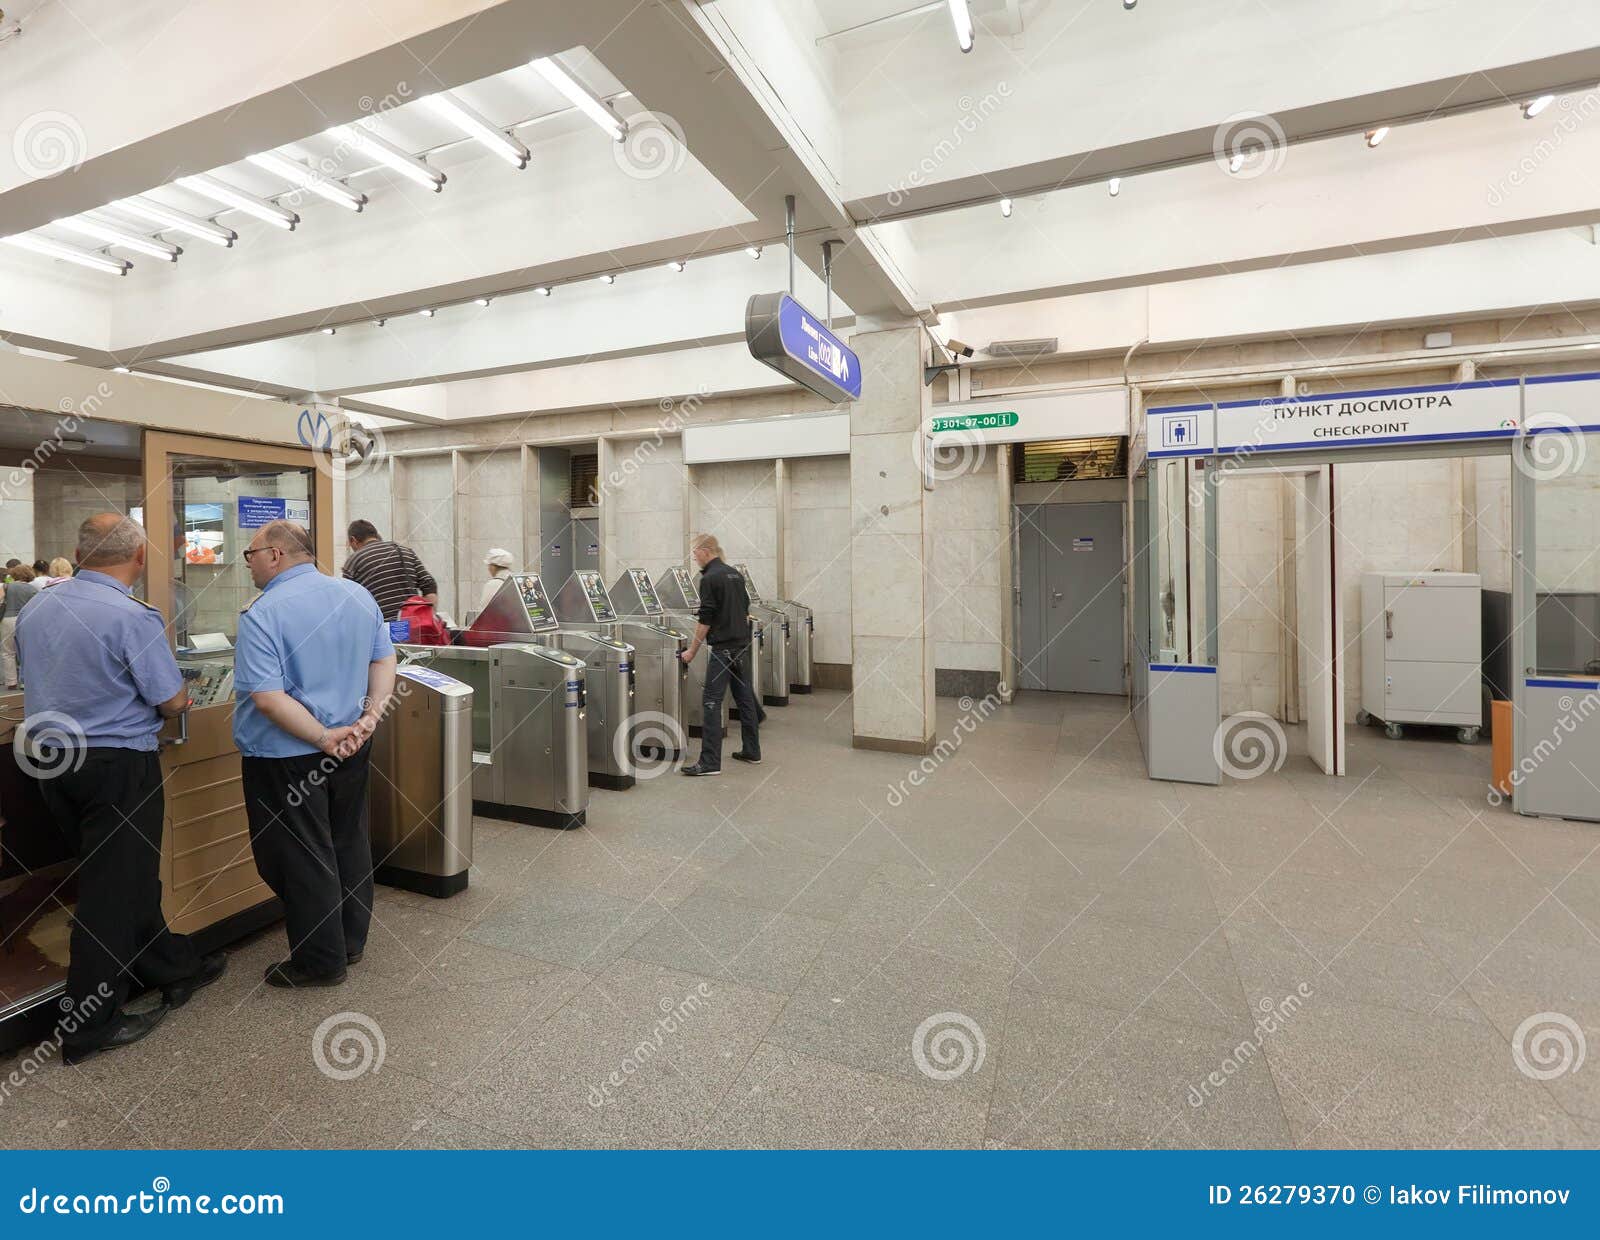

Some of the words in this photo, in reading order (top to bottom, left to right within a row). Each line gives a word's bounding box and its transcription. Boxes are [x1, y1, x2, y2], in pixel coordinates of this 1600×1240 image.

[1274, 403, 1335, 419] ПУНКТ
[1338, 395, 1453, 417] ДОСМОТРА
[943, 416, 997, 429] 301-97-00
[1313, 422, 1410, 438] CHECKPOINT
